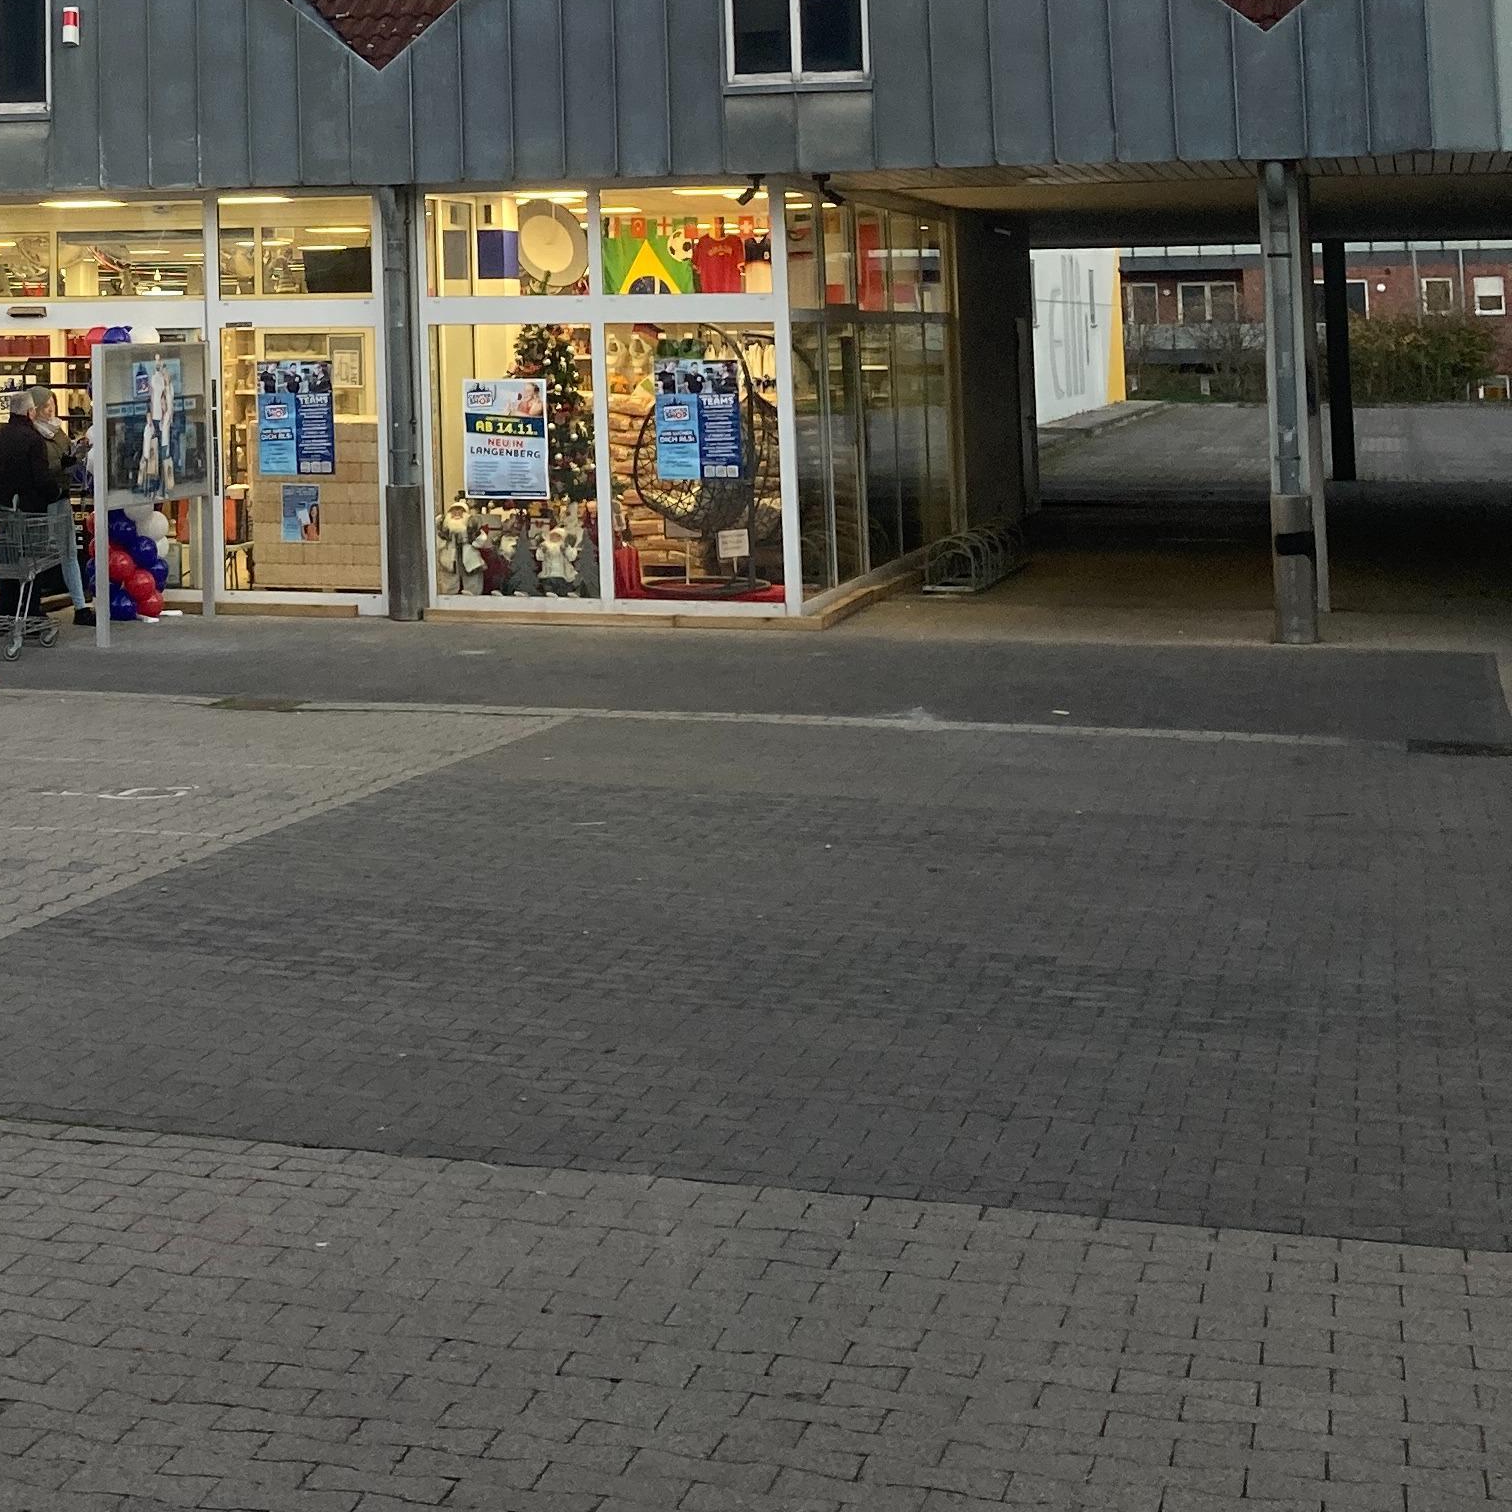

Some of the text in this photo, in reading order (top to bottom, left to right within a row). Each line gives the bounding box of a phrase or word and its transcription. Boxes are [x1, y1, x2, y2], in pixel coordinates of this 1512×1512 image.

[701, 397, 734, 406] TEAMS
[475, 420, 538, 436] AB 14.11.
[487, 438, 524, 449] NEU IN
[470, 446, 541, 459] LANGENBERG
